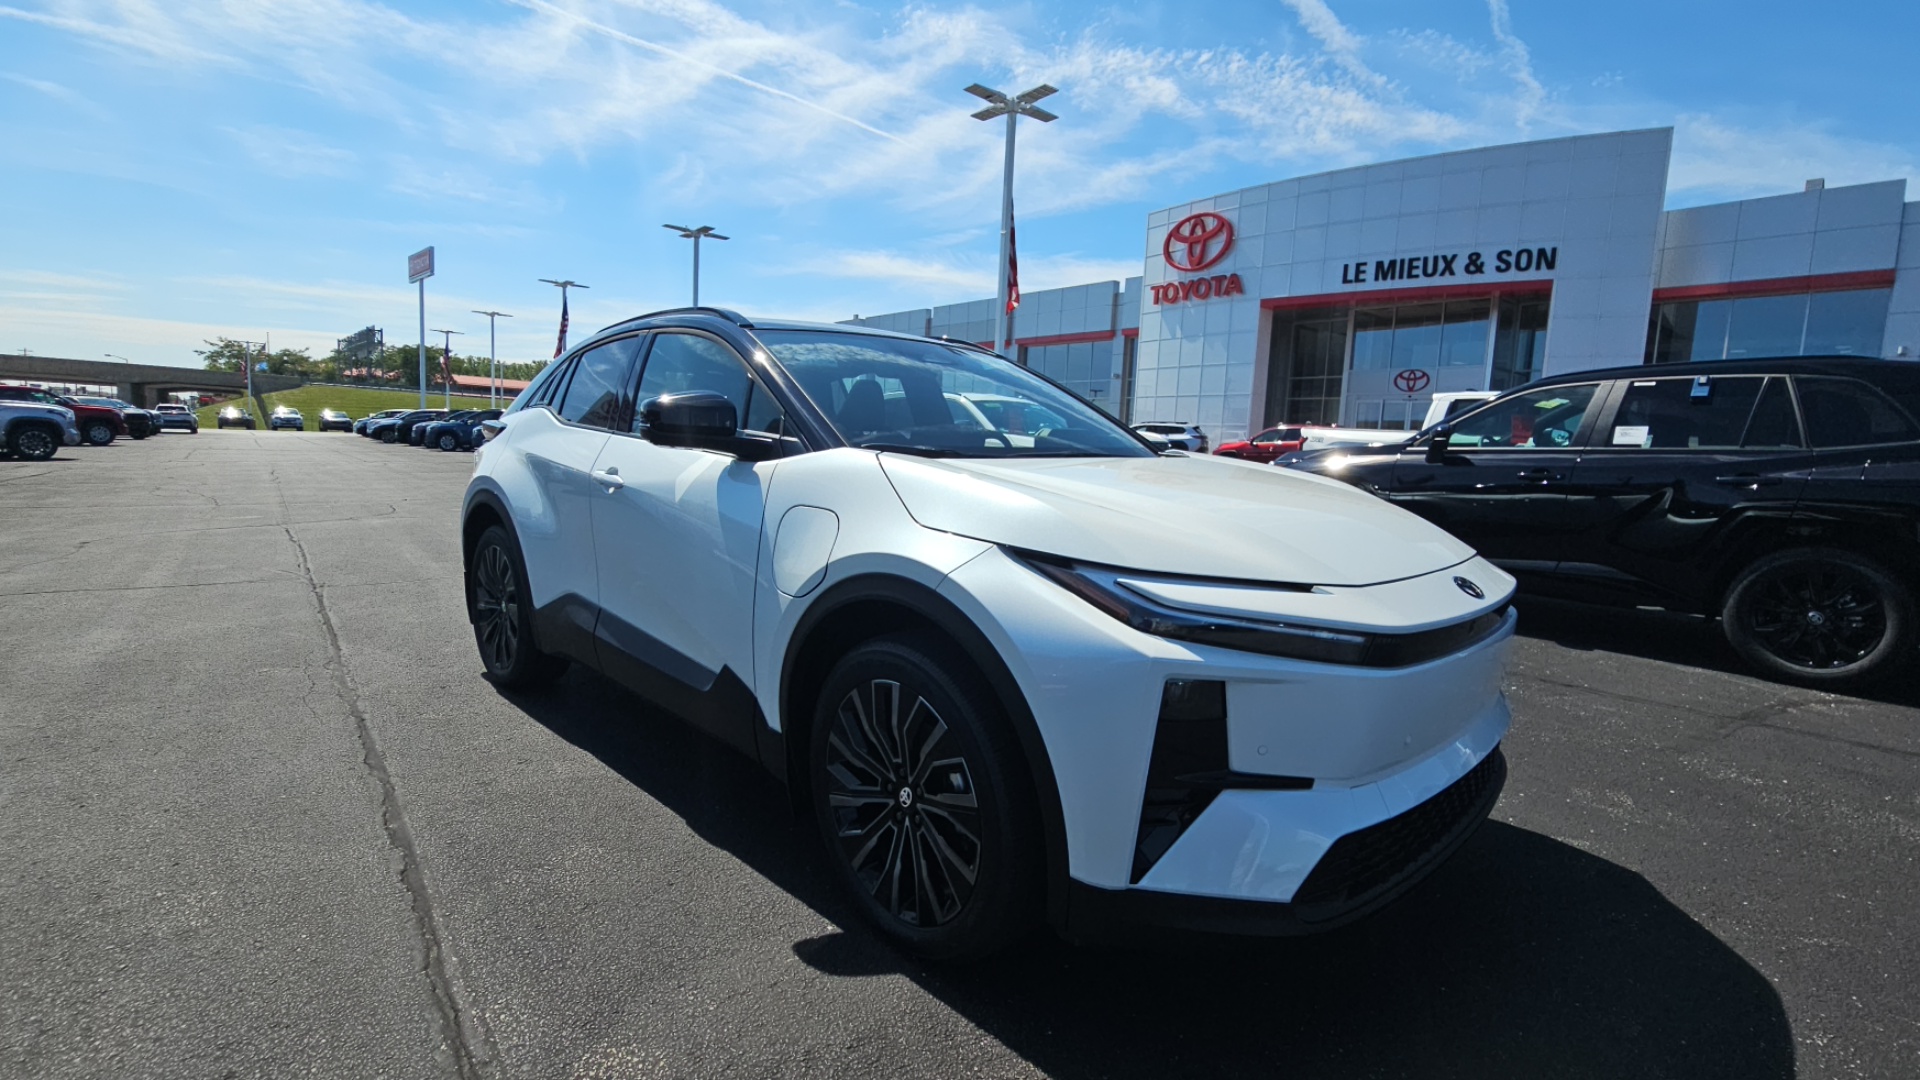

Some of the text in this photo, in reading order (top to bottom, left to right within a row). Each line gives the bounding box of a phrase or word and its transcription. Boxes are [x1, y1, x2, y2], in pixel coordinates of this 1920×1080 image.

[1342, 247, 1557, 284] LE MIEUX & SON
[1150, 273, 1244, 305] TOYOTA
